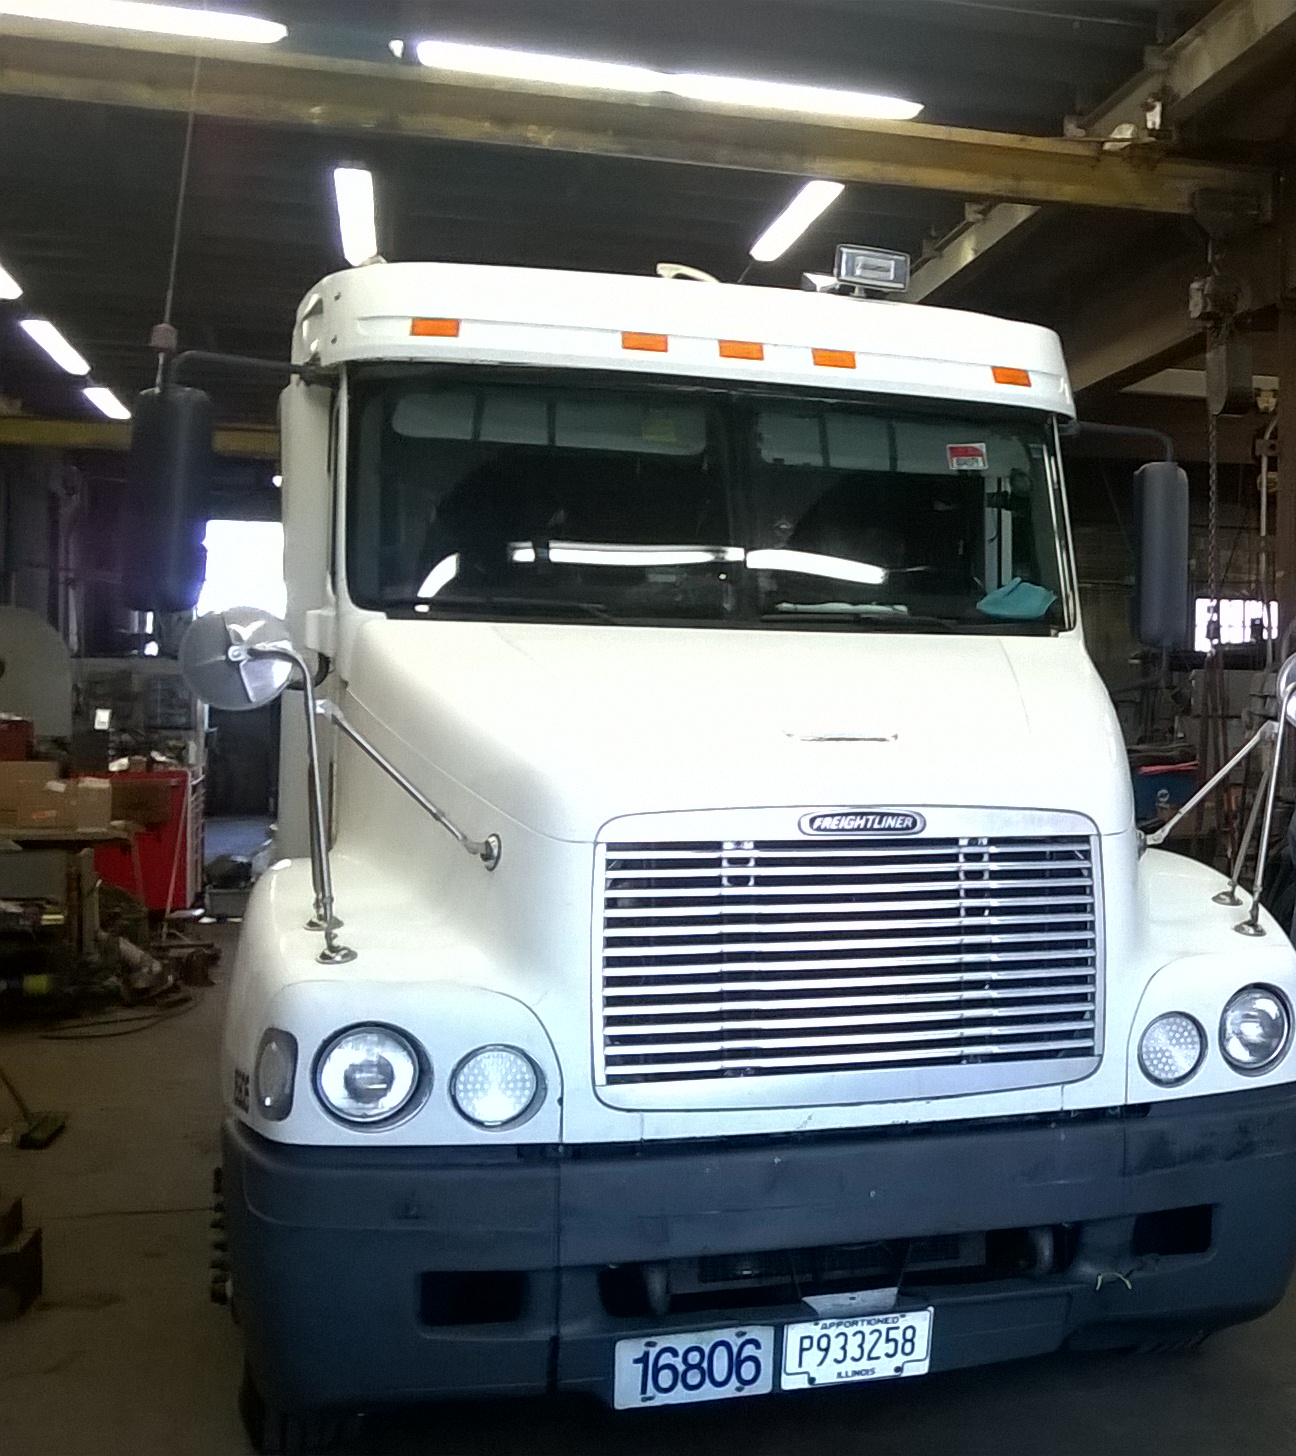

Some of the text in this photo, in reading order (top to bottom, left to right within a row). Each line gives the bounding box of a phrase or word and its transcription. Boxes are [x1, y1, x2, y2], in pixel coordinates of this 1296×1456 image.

[812, 814, 914, 830] FREIGHTLINER
[820, 1315, 900, 1331] APPORTIONED
[799, 1325, 917, 1369] P933258
[632, 1337, 763, 1397] 16806
[836, 1366, 877, 1380] ILLINOIS
